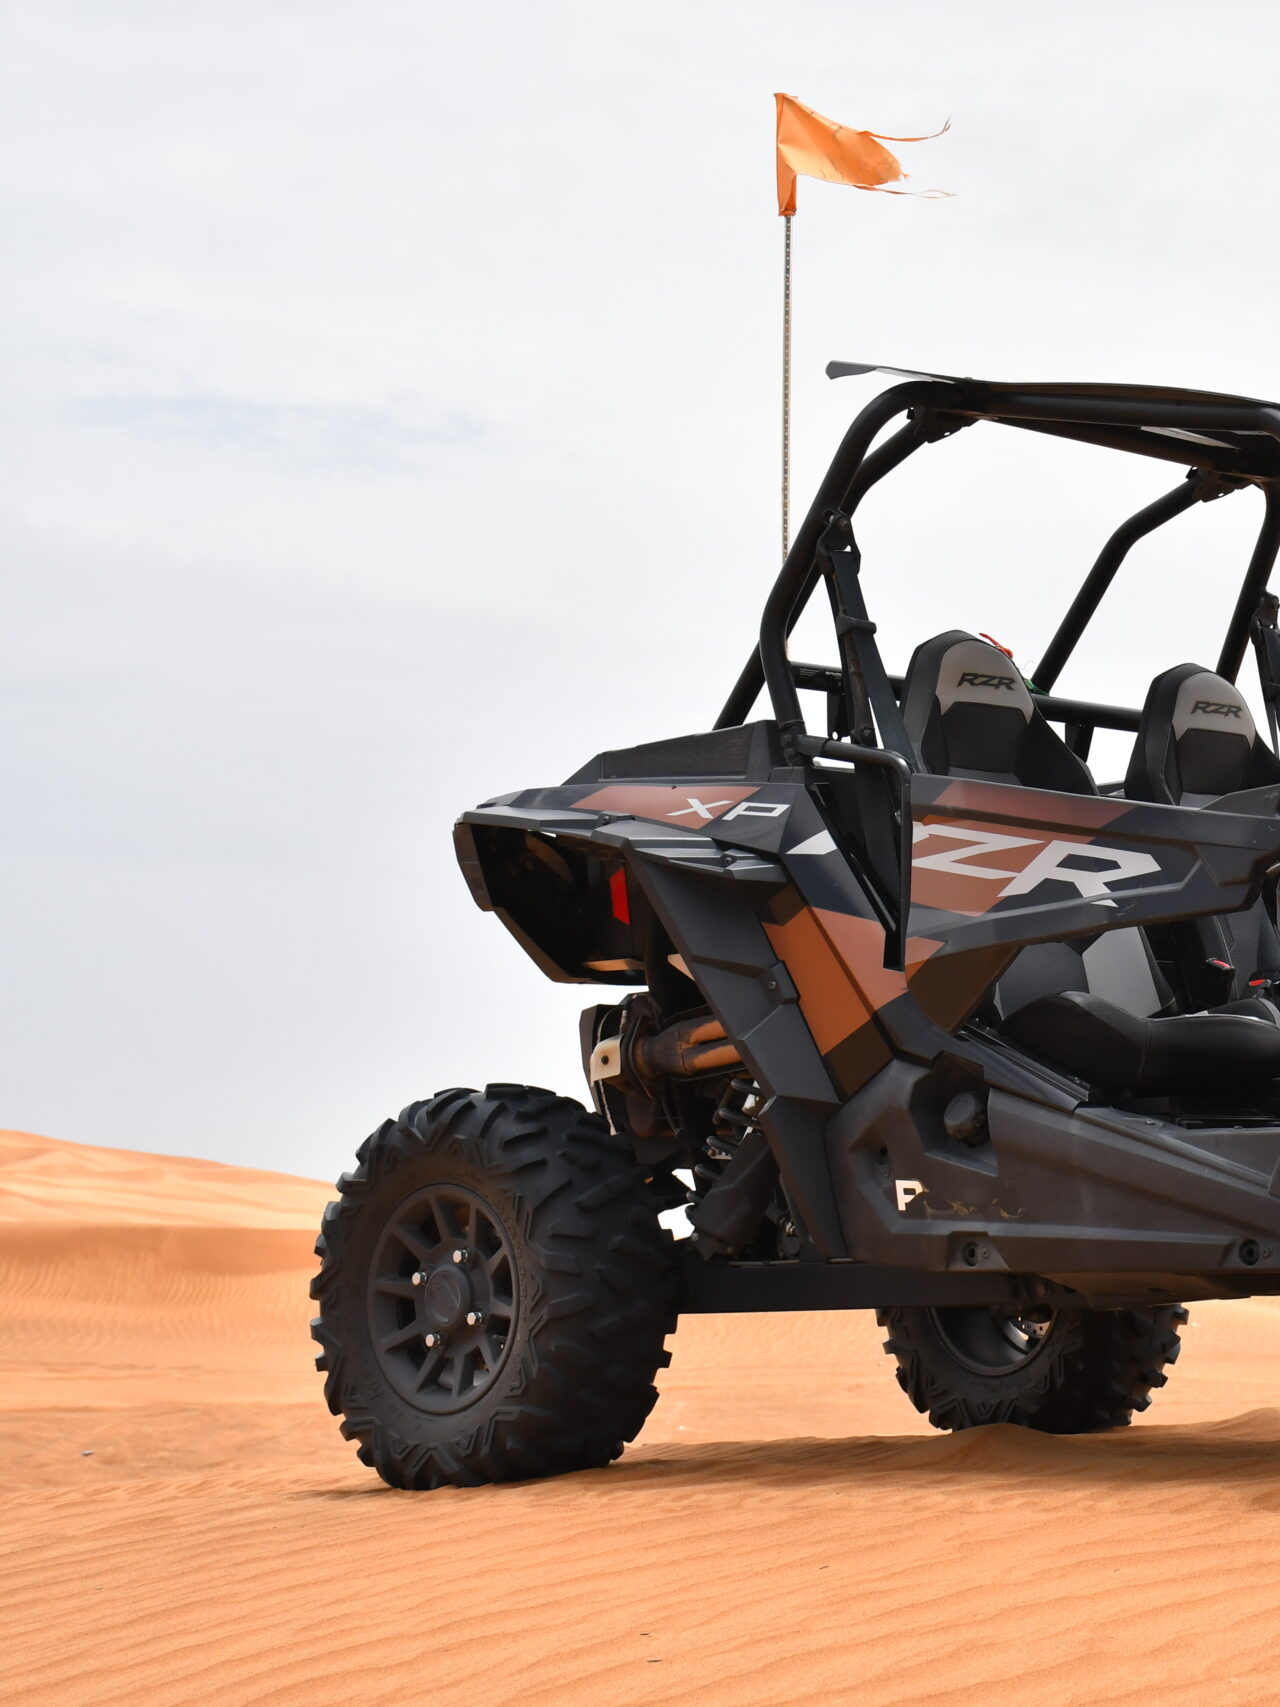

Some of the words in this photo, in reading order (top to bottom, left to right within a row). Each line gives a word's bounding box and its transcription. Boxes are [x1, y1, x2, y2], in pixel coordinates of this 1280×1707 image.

[957, 672, 1016, 691] RZR
[1190, 701, 1243, 719] RZR
[665, 798, 791, 820] XP
